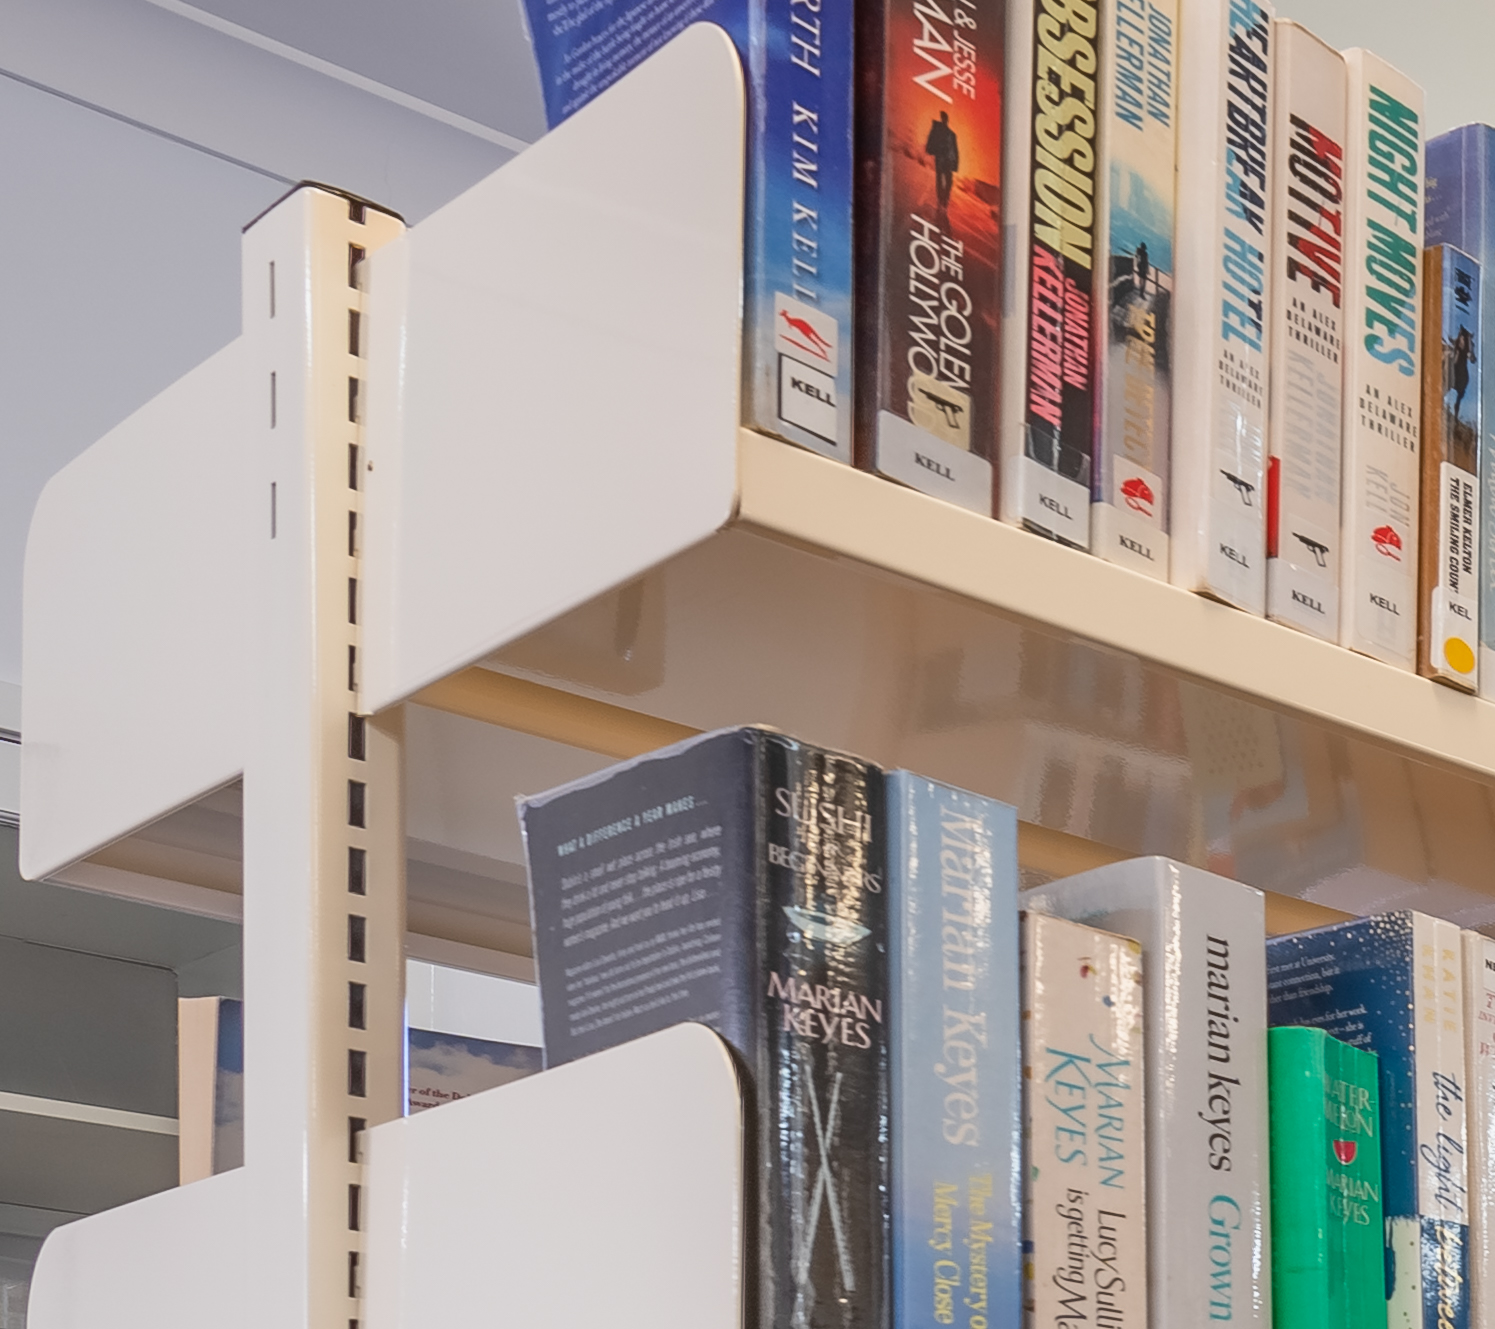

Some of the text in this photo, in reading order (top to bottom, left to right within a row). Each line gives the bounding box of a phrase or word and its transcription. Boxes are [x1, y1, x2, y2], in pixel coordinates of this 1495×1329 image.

[791, 100, 820, 191] KIM
[1286, 112, 1344, 308] MOTIVE
[1364, 83, 1419, 379] NIGHT MOVES
[789, 374, 836, 409] KELL
[1028, 244, 1089, 426] JONATHAN KELLERMAN
[1448, 599, 1473, 621] KEL
[1207, 1192, 1243, 1322] Grown
